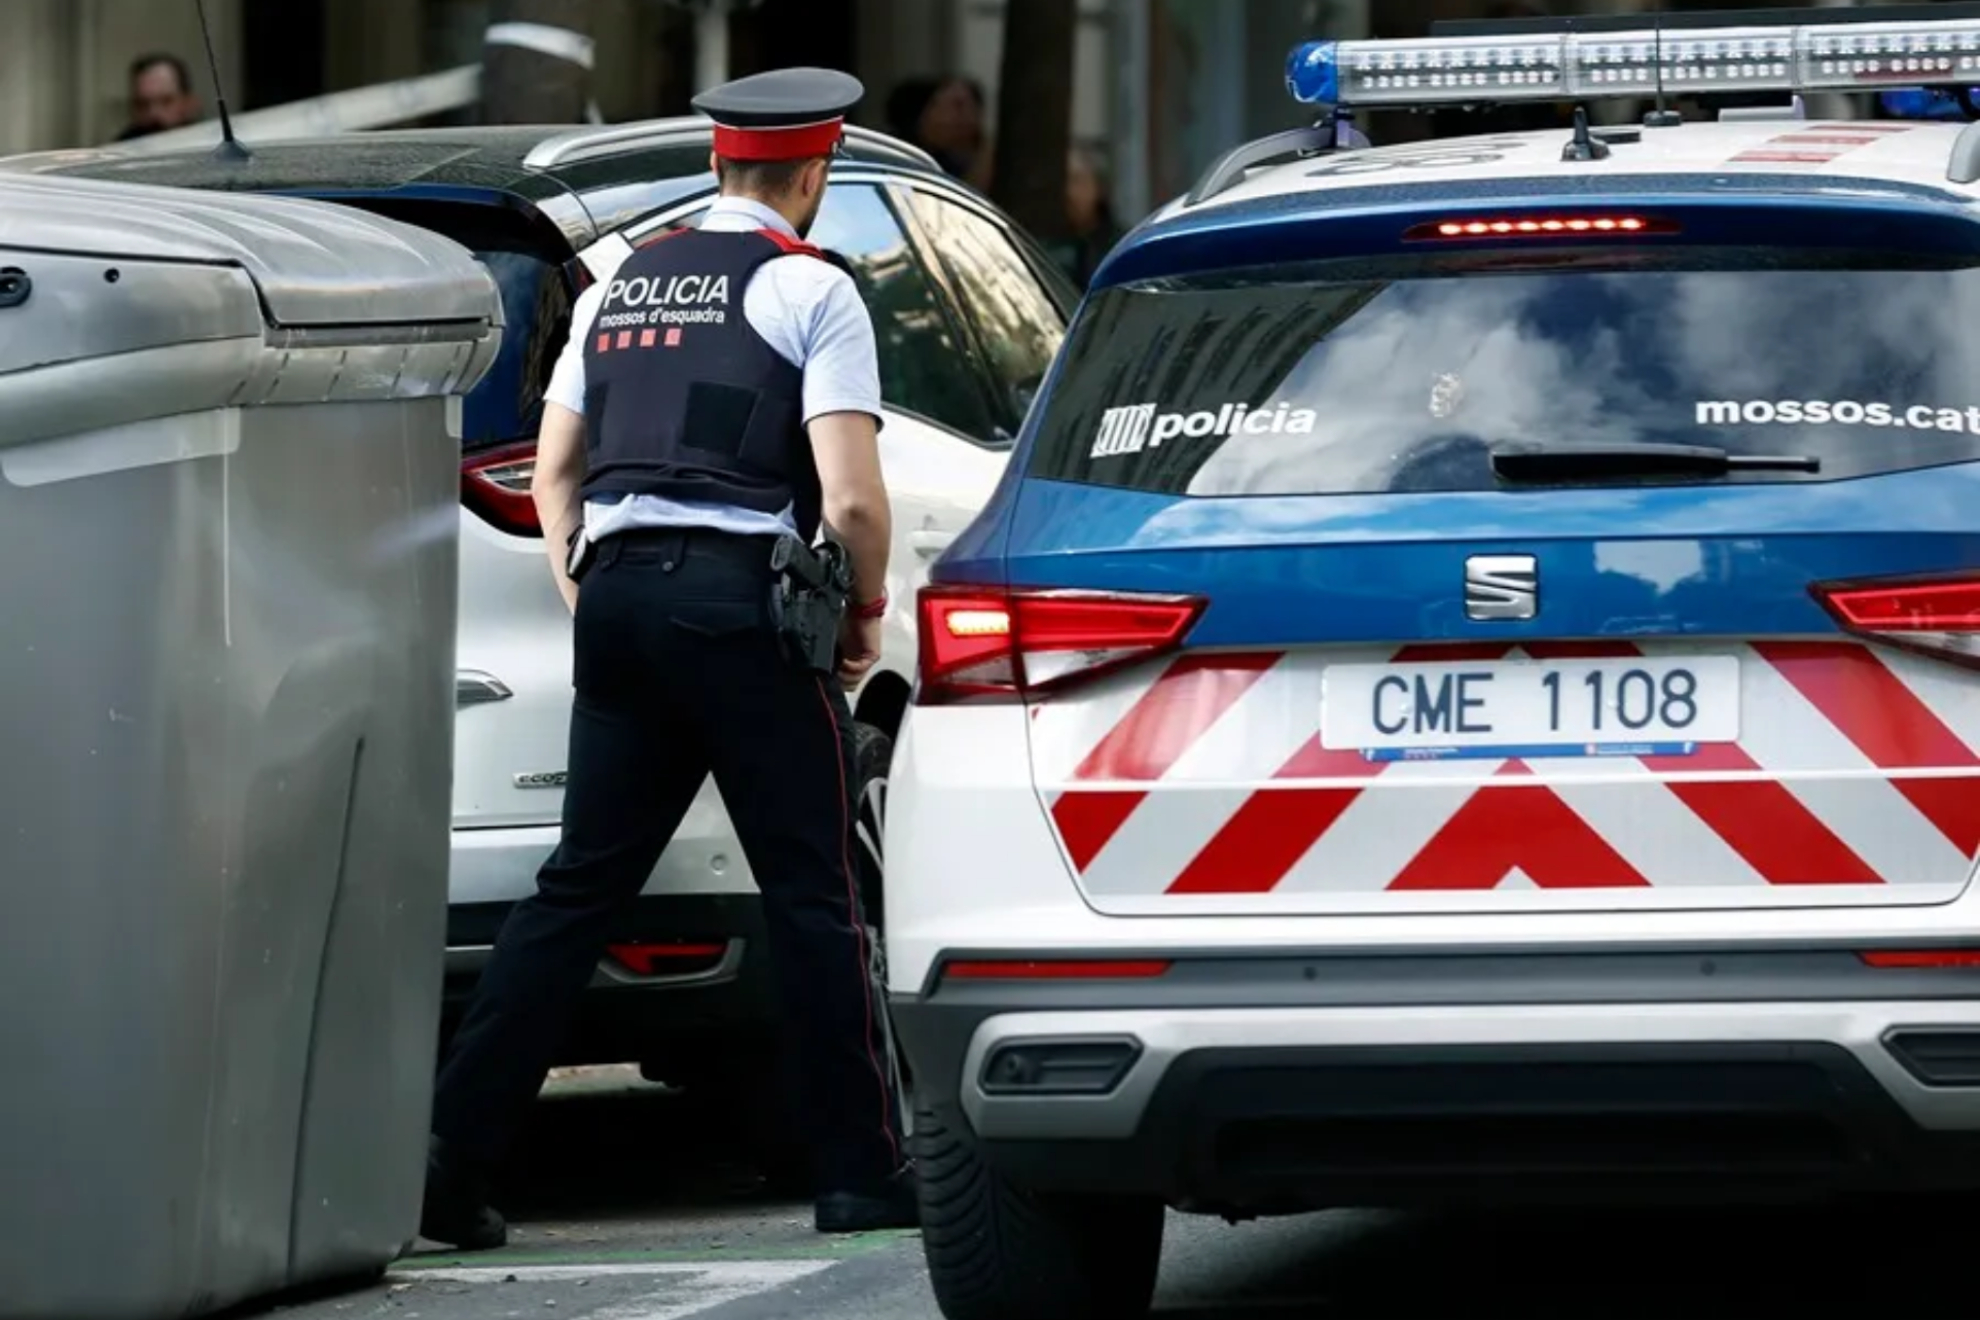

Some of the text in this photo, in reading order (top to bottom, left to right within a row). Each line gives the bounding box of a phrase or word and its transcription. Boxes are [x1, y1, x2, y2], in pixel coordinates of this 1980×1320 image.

[603, 275, 729, 309] POLICIA
[599, 306, 726, 328] mossos d'esquadra
[1148, 402, 1318, 447] policia
[1695, 399, 1980, 434] mossos.cat
[1372, 668, 1698, 735] CME 1108
